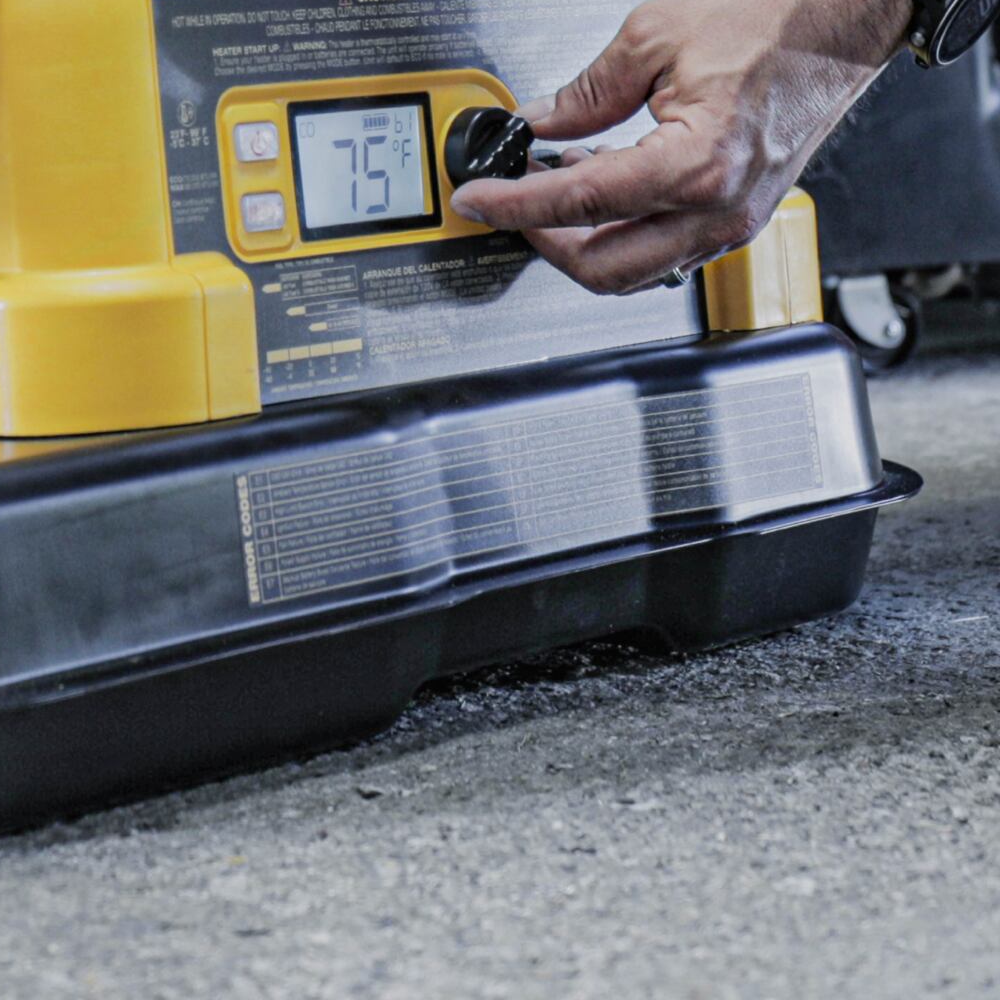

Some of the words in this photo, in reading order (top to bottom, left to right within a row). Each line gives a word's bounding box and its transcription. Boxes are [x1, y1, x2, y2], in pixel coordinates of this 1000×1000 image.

[211, 45, 241, 57] HEATER
[243, 43, 266, 55] START
[332, 135, 390, 214] 75
[362, 266, 402, 281] ARRANQUE
[403, 264, 417, 275] DEL
[236, 475, 253, 537] CODES
[244, 541, 261, 603] ERROR
